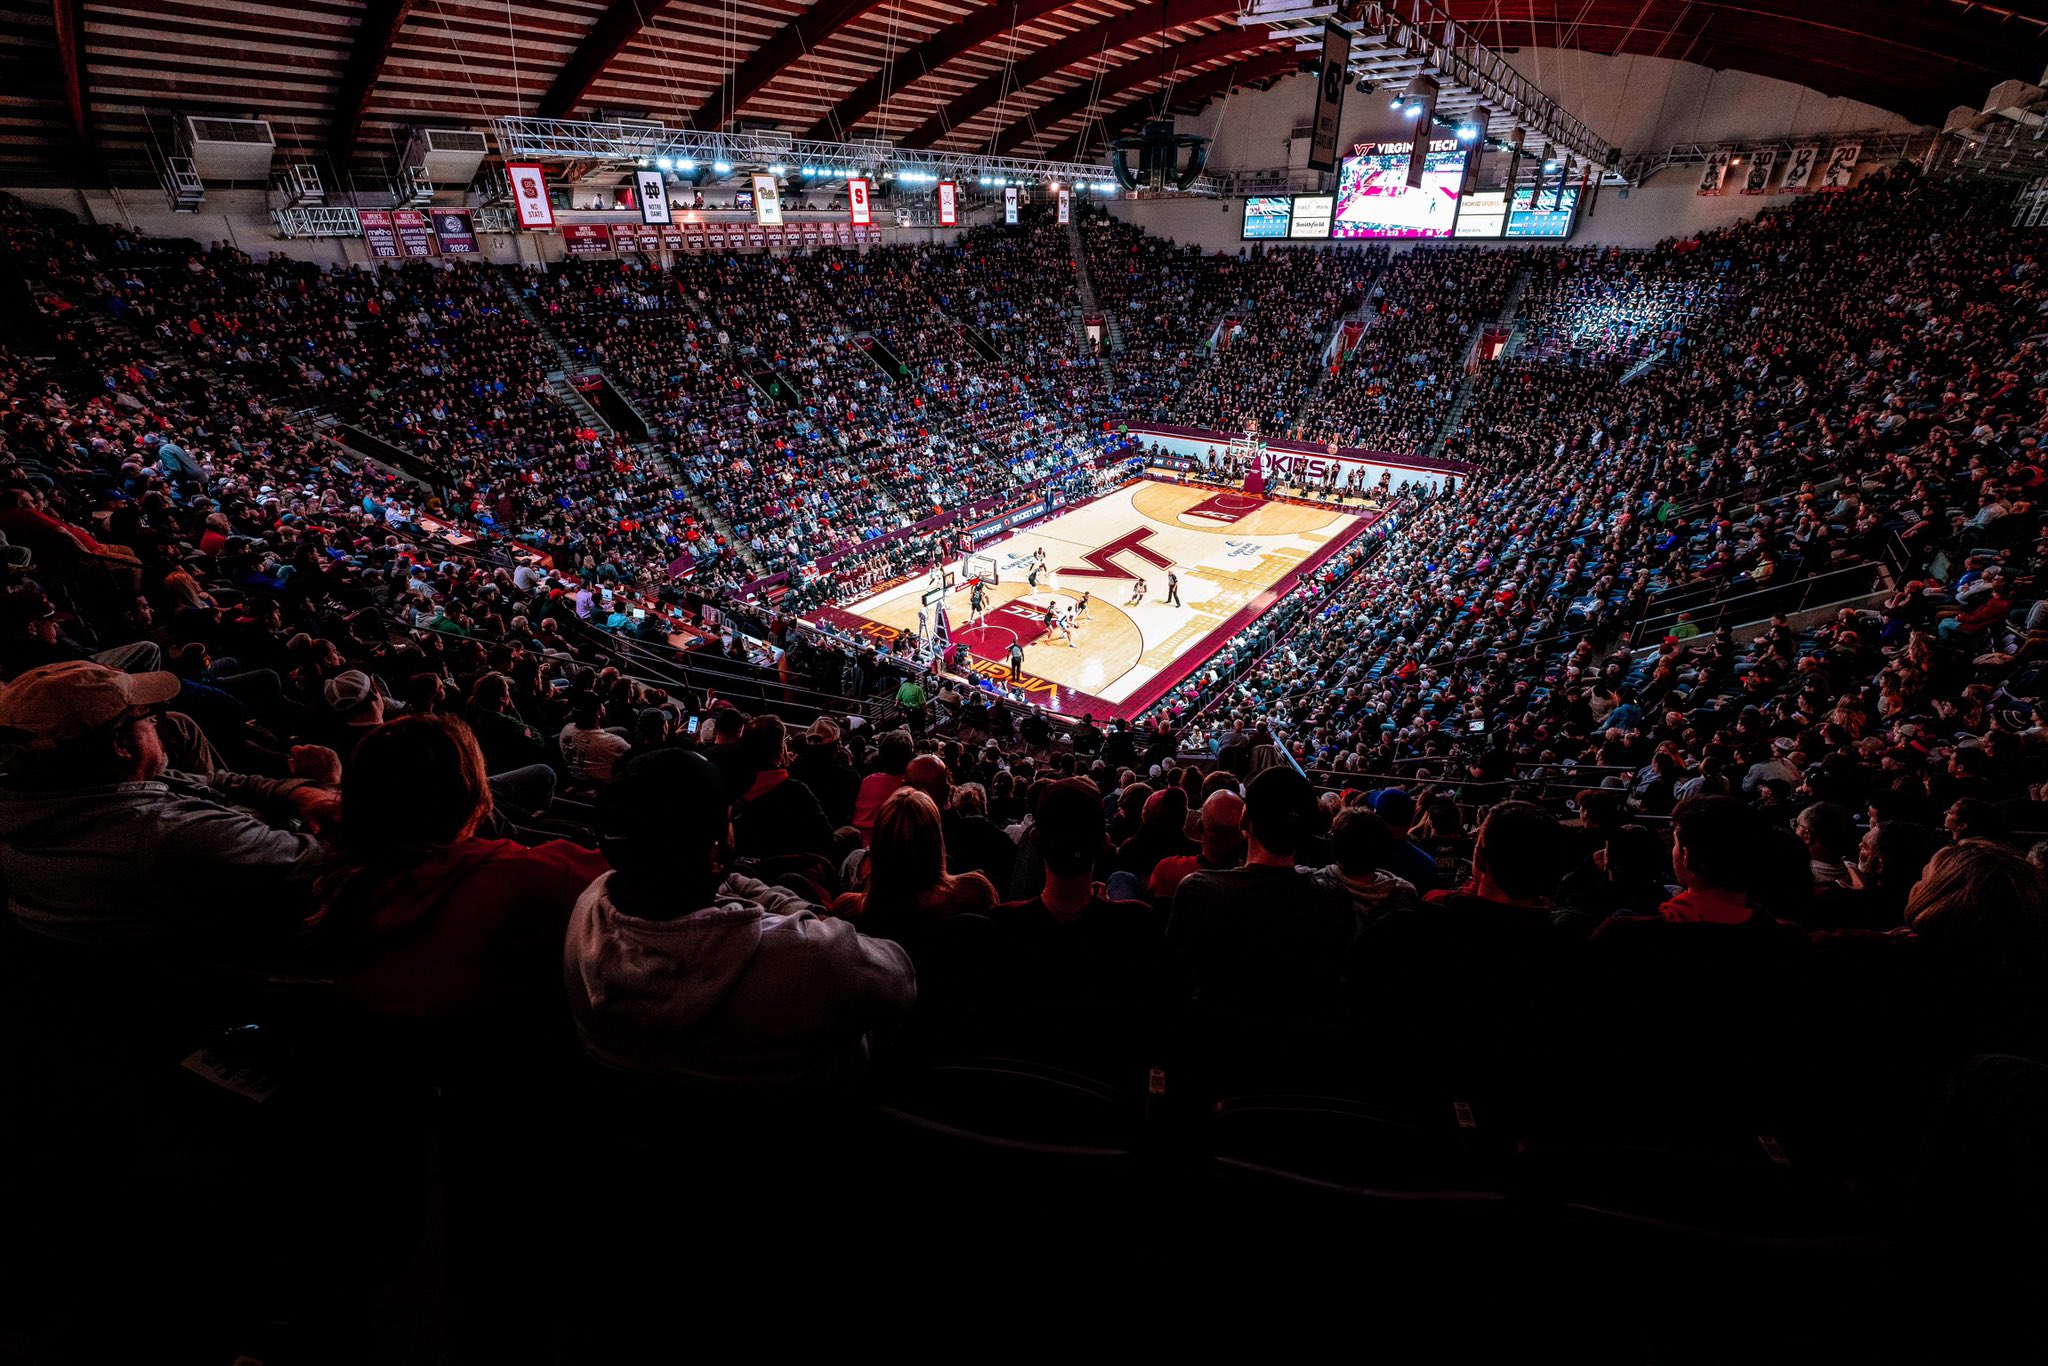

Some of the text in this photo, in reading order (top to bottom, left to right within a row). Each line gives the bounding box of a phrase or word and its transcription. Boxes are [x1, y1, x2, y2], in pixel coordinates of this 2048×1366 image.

[1354, 140, 1458, 156] VT VIRGIN TECH
[1708, 154, 1727, 166] 44
[1753, 152, 1774, 164] 30
[1796, 150, 1813, 163] 12
[1836, 148, 1857, 161] 20
[376, 247, 395, 256] 1979
[409, 246, 428, 255] 1996
[450, 244, 470, 252] 2022
[979, 525, 1002, 538] Mortgage
[1012, 509, 1032, 523] ROCKET
[1033, 505, 1044, 514] CAN
[859, 621, 900, 642] CH
